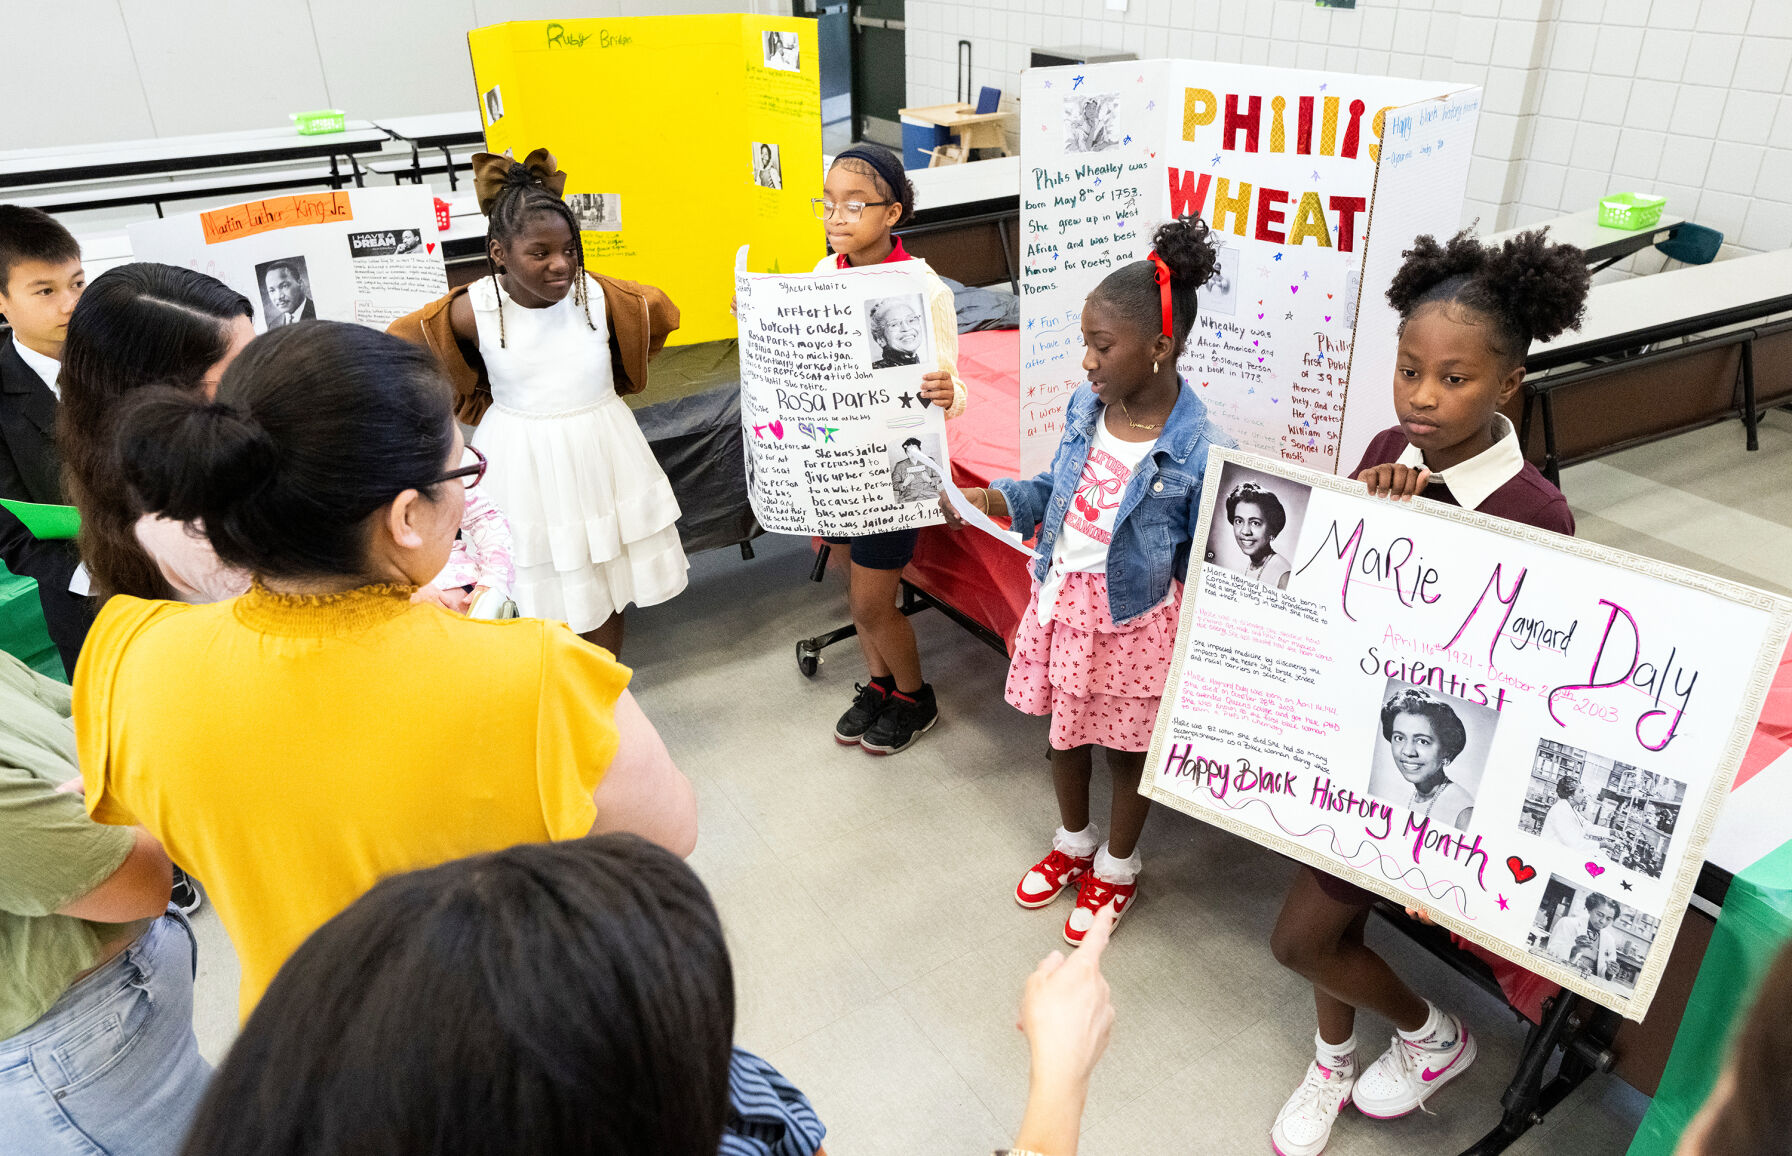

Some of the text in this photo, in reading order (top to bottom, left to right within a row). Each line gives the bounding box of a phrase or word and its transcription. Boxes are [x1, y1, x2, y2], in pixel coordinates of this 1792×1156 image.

[1075, 162, 1124, 181] Wheatley
[1128, 161, 1148, 171] was
[1025, 200, 1046, 210] born
[1054, 196, 1077, 209] May
[1095, 190, 1106, 202] of
[293, 195, 325, 224] King
[1168, 167, 1366, 252] WHEAT
[1029, 208, 1139, 235] She grew up in West
[357, 232, 385, 240] HAVE
[353, 237, 397, 249] DREAM
[1027, 230, 1137, 257] Africa and was best
[1065, 259, 1077, 271] for
[1116, 249, 1133, 261] and
[760, 318, 801, 335] boycott
[1040, 316, 1060, 329] Fun
[1200, 316, 1271, 339] Wheatley was
[797, 340, 833, 348] moved
[836, 340, 852, 348] to
[1039, 340, 1060, 352] have
[774, 349, 790, 358] and
[793, 349, 804, 360] to
[1261, 349, 1274, 357] and
[1211, 355, 1242, 368] enslaved
[854, 370, 874, 380] John
[1207, 365, 1225, 374] book
[1301, 370, 1332, 385] of 39
[1040, 384, 1060, 394] Fun
[1292, 382, 1320, 394] themes
[1314, 401, 1327, 410] and
[1292, 408, 1305, 418] Her
[1288, 424, 1320, 437] William
[835, 446, 855, 457] was
[820, 458, 880, 471] refusing to
[804, 467, 890, 485] give up her seat
[808, 486, 822, 495] to
[833, 482, 862, 493] white
[812, 493, 884, 506] because the
[815, 507, 836, 518] bus
[839, 507, 860, 518] was
[1300, 598, 1317, 608] born
[1442, 563, 1578, 667] Maynard
[1382, 624, 1417, 652] April
[1488, 664, 1536, 691] October
[1573, 697, 1620, 723] 2003
[1548, 598, 1699, 751] Daly
[1163, 744, 1488, 892] Happy Black History Month
